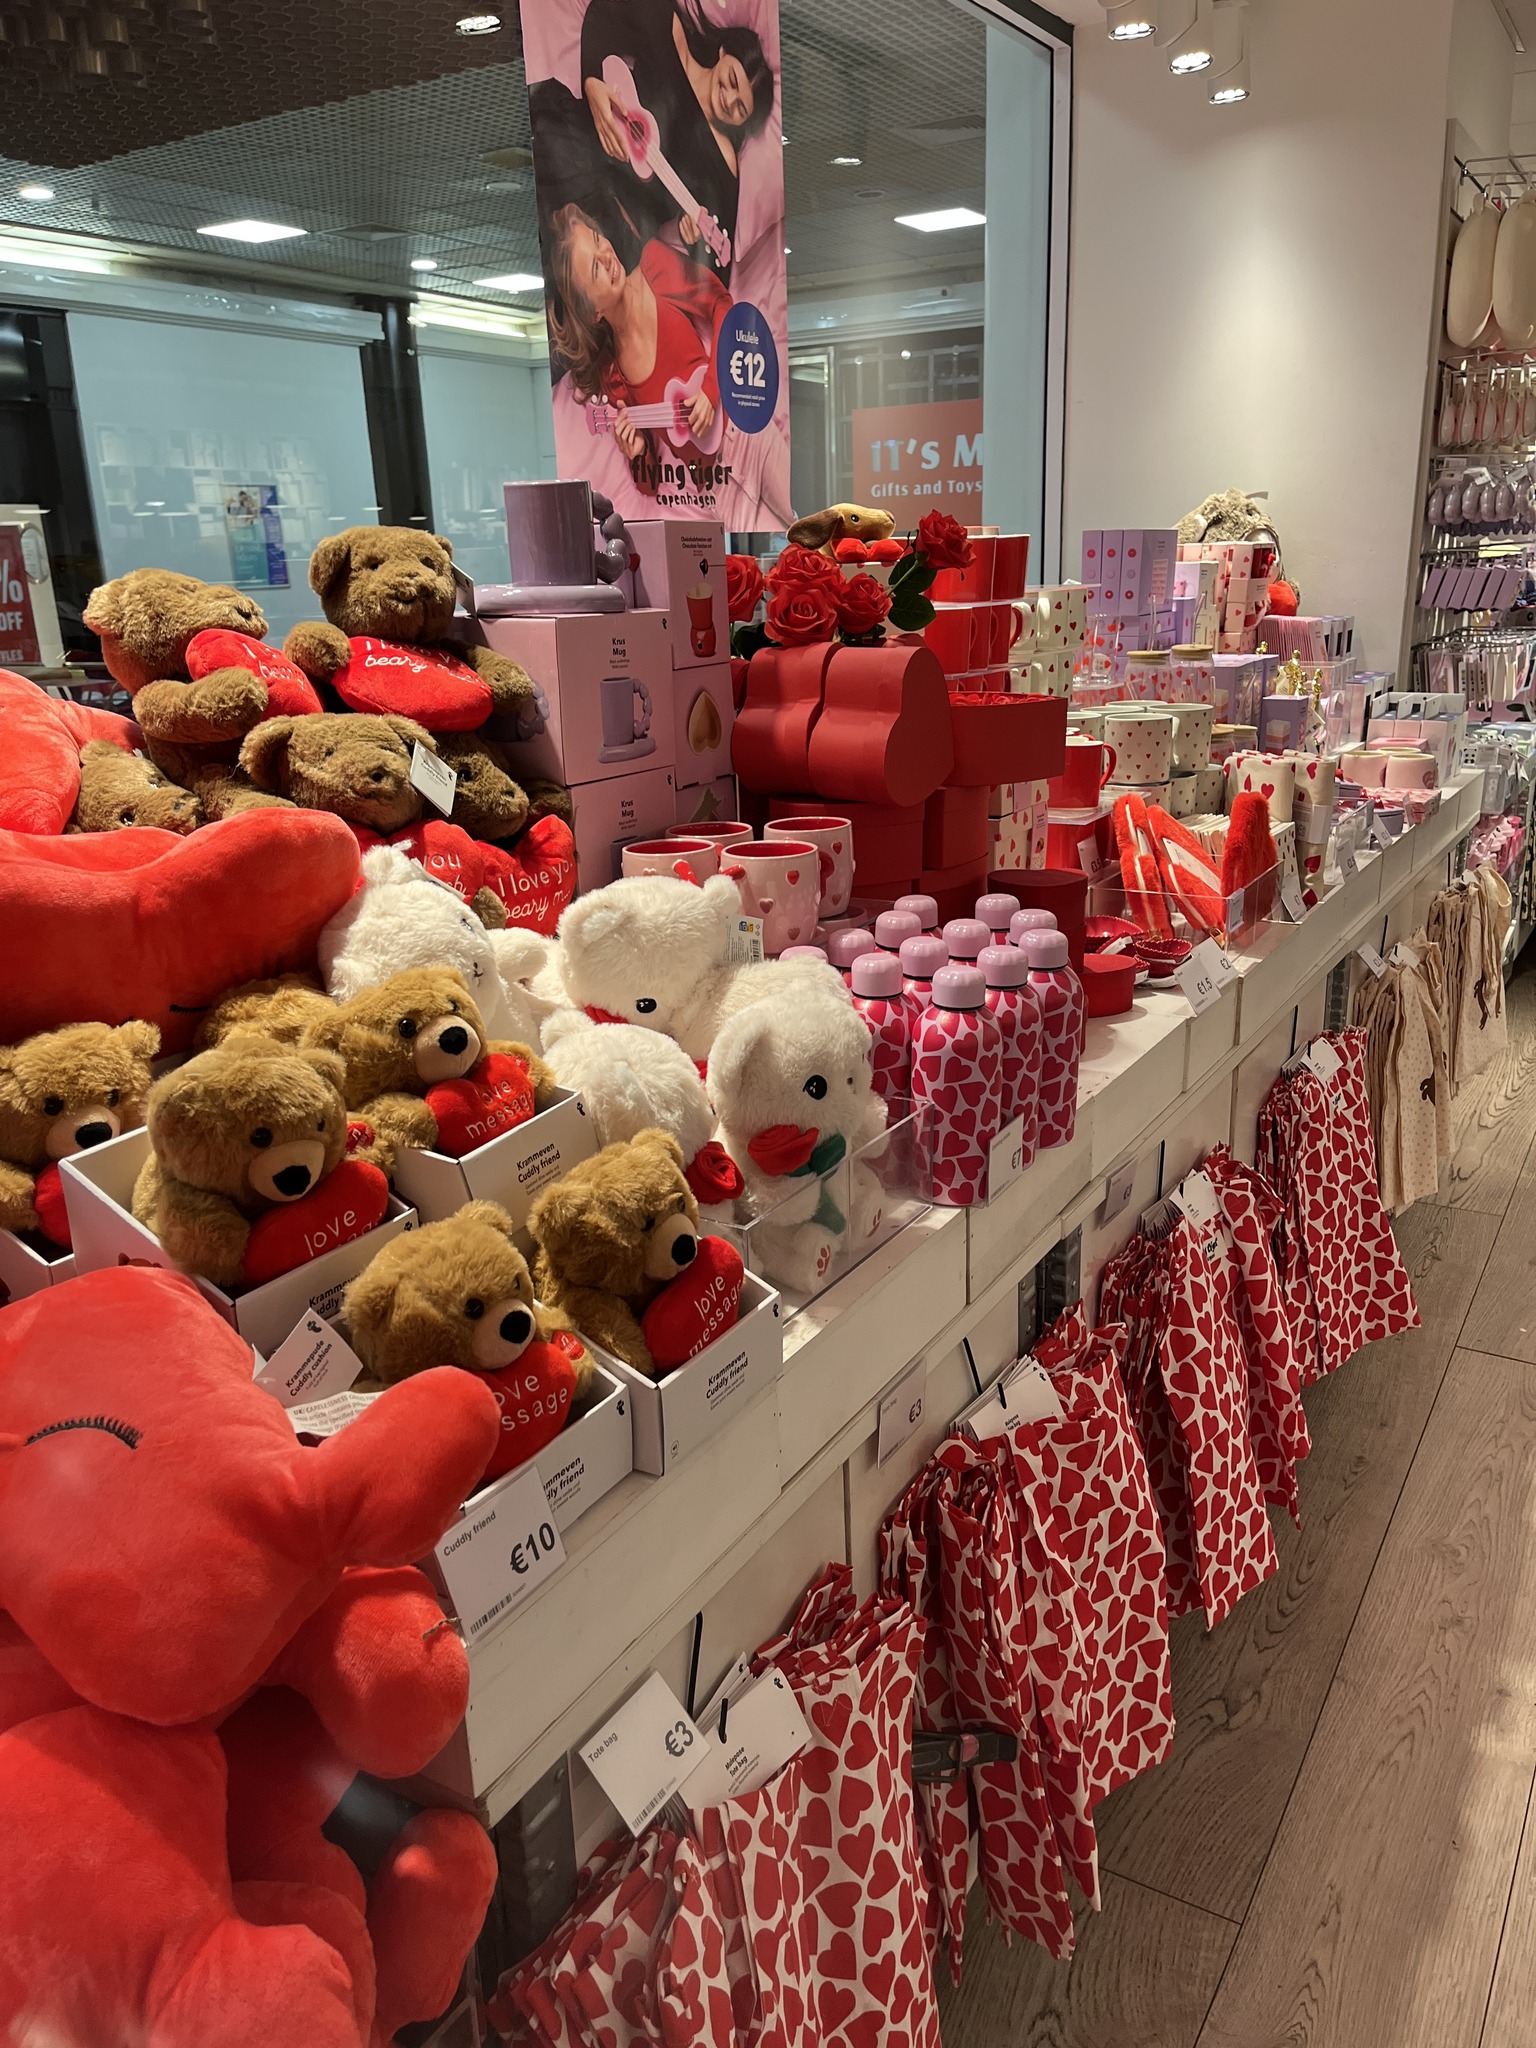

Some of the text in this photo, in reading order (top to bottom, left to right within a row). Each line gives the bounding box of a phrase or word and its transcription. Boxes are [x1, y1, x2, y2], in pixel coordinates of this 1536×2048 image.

[735, 329, 760, 345] Ukulele
[729, 350, 766, 388] €12
[870, 438, 941, 472] IT'S
[631, 453, 733, 491] flying tiger
[871, 479, 983, 498] Gifts and Toys
[655, 492, 717, 509] copenhagen
[612, 637, 626, 646] Krus
[612, 648, 627, 657] Mug
[365, 654, 428, 673] beary
[498, 859, 573, 898] I love yo
[1196, 977, 1213, 995] €1.5
[474, 1080, 512, 1106] love
[516, 1142, 555, 1172] Krammeven
[517, 1150, 562, 1184] Cuddly friend
[1011, 1147, 1022, 1170] €7
[304, 1210, 358, 1257] love
[694, 1276, 726, 1321] love
[285, 1340, 325, 1388] Krammepude
[289, 1370, 313, 1397] Cuddly
[311, 1343, 333, 1371] cushion
[706, 1357, 749, 1399] Cuddly friend
[708, 1351, 746, 1387] Krammeven
[305, 1394, 348, 1414] CARELESSNESS
[492, 1375, 540, 1407] ove
[501, 1388, 568, 1431] ssage
[908, 1398, 922, 1424] €3
[543, 1457, 581, 1491] mmeven
[559, 1463, 586, 1490] friend
[443, 1510, 497, 1557] Cuddly friend
[510, 1522, 556, 1574] €10
[588, 1732, 619, 1763] Tote bag
[664, 1721, 694, 1757] €3
[735, 1755, 748, 1768] bag
